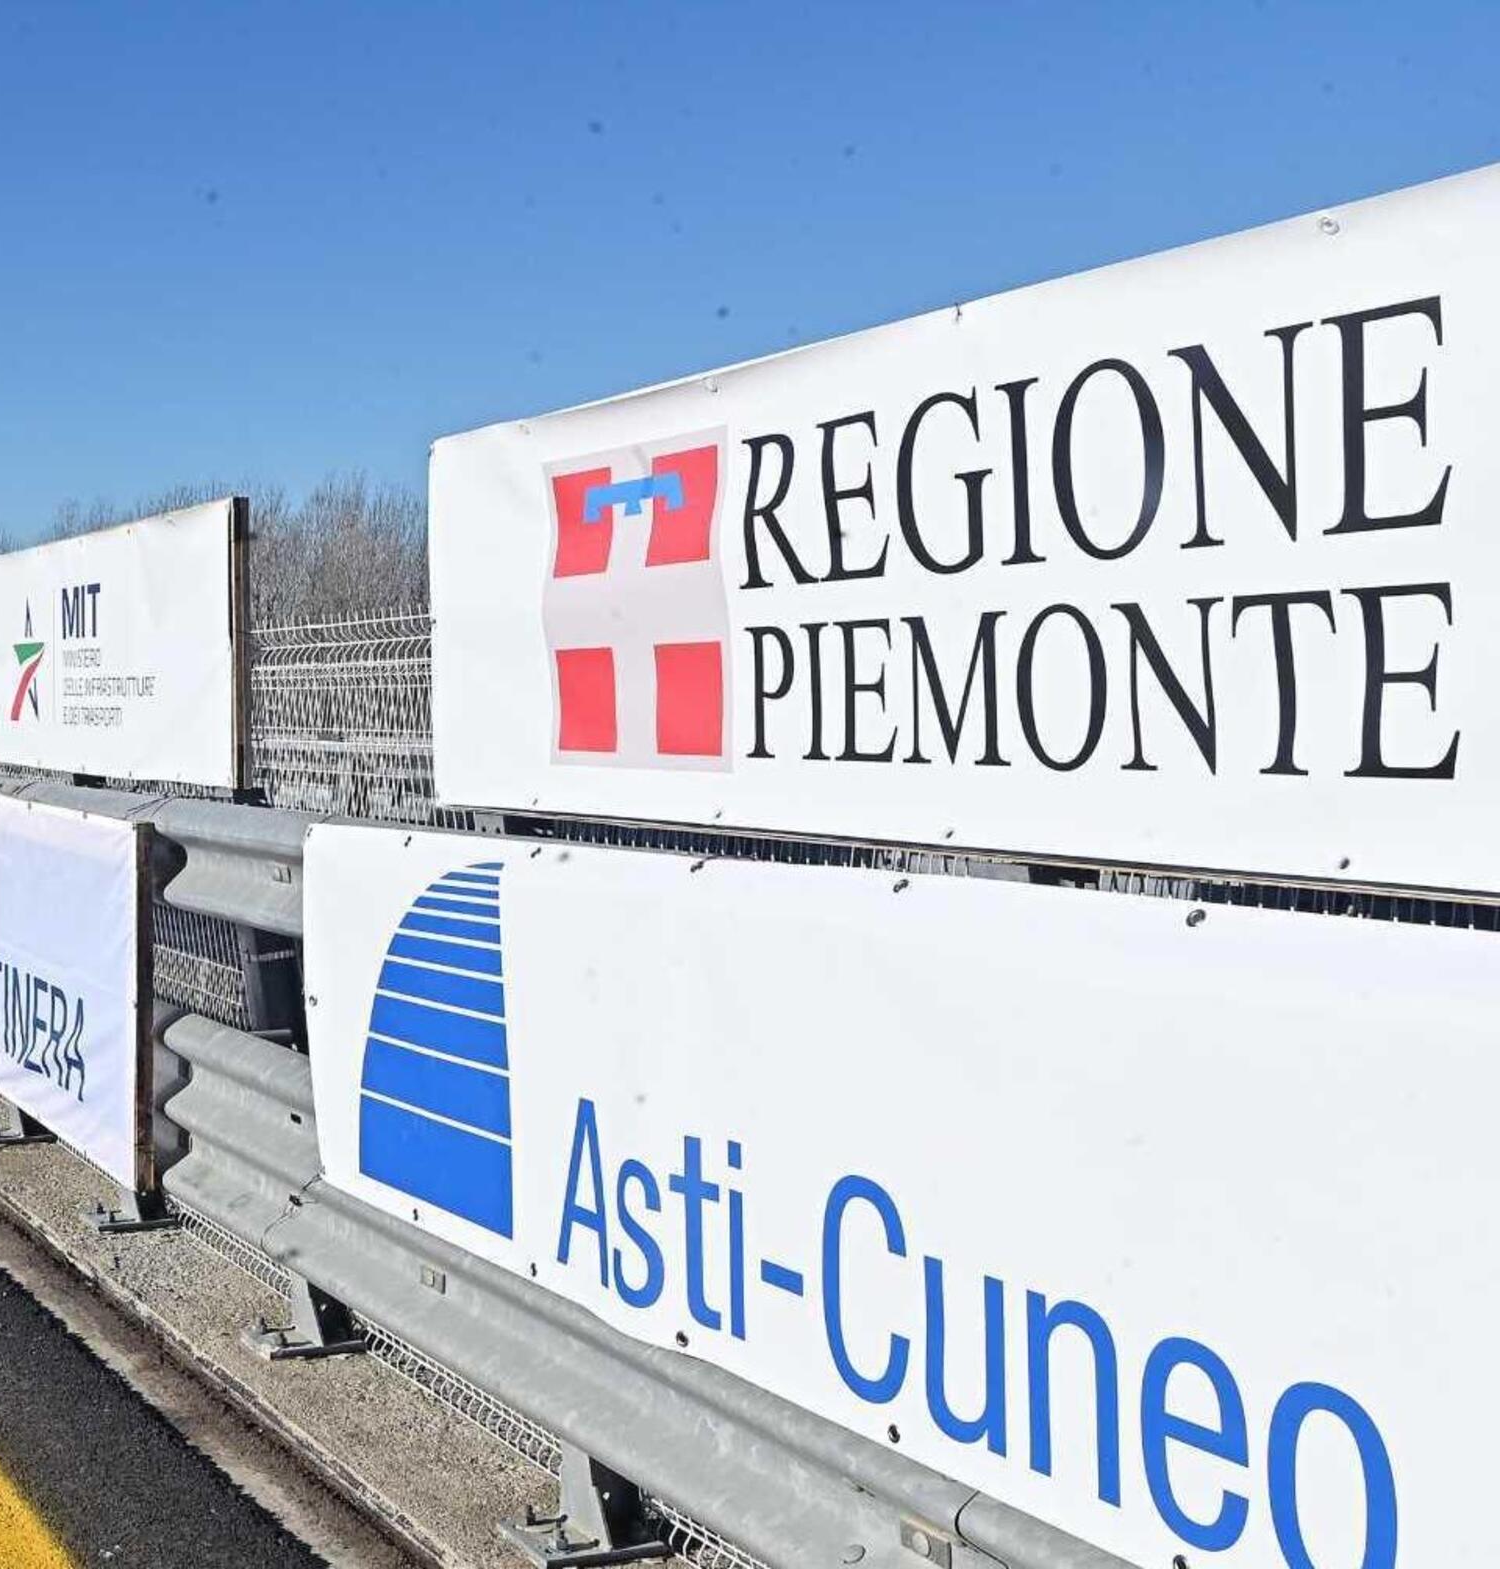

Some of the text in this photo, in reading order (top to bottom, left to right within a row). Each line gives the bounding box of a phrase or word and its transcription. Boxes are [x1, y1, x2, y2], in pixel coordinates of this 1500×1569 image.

[739, 295, 1453, 589] REGIONE
[62, 583, 101, 640] MIT
[744, 582, 1461, 780] PIEMONTE
[557, 1097, 1398, 1569] Asti-Cuneo
